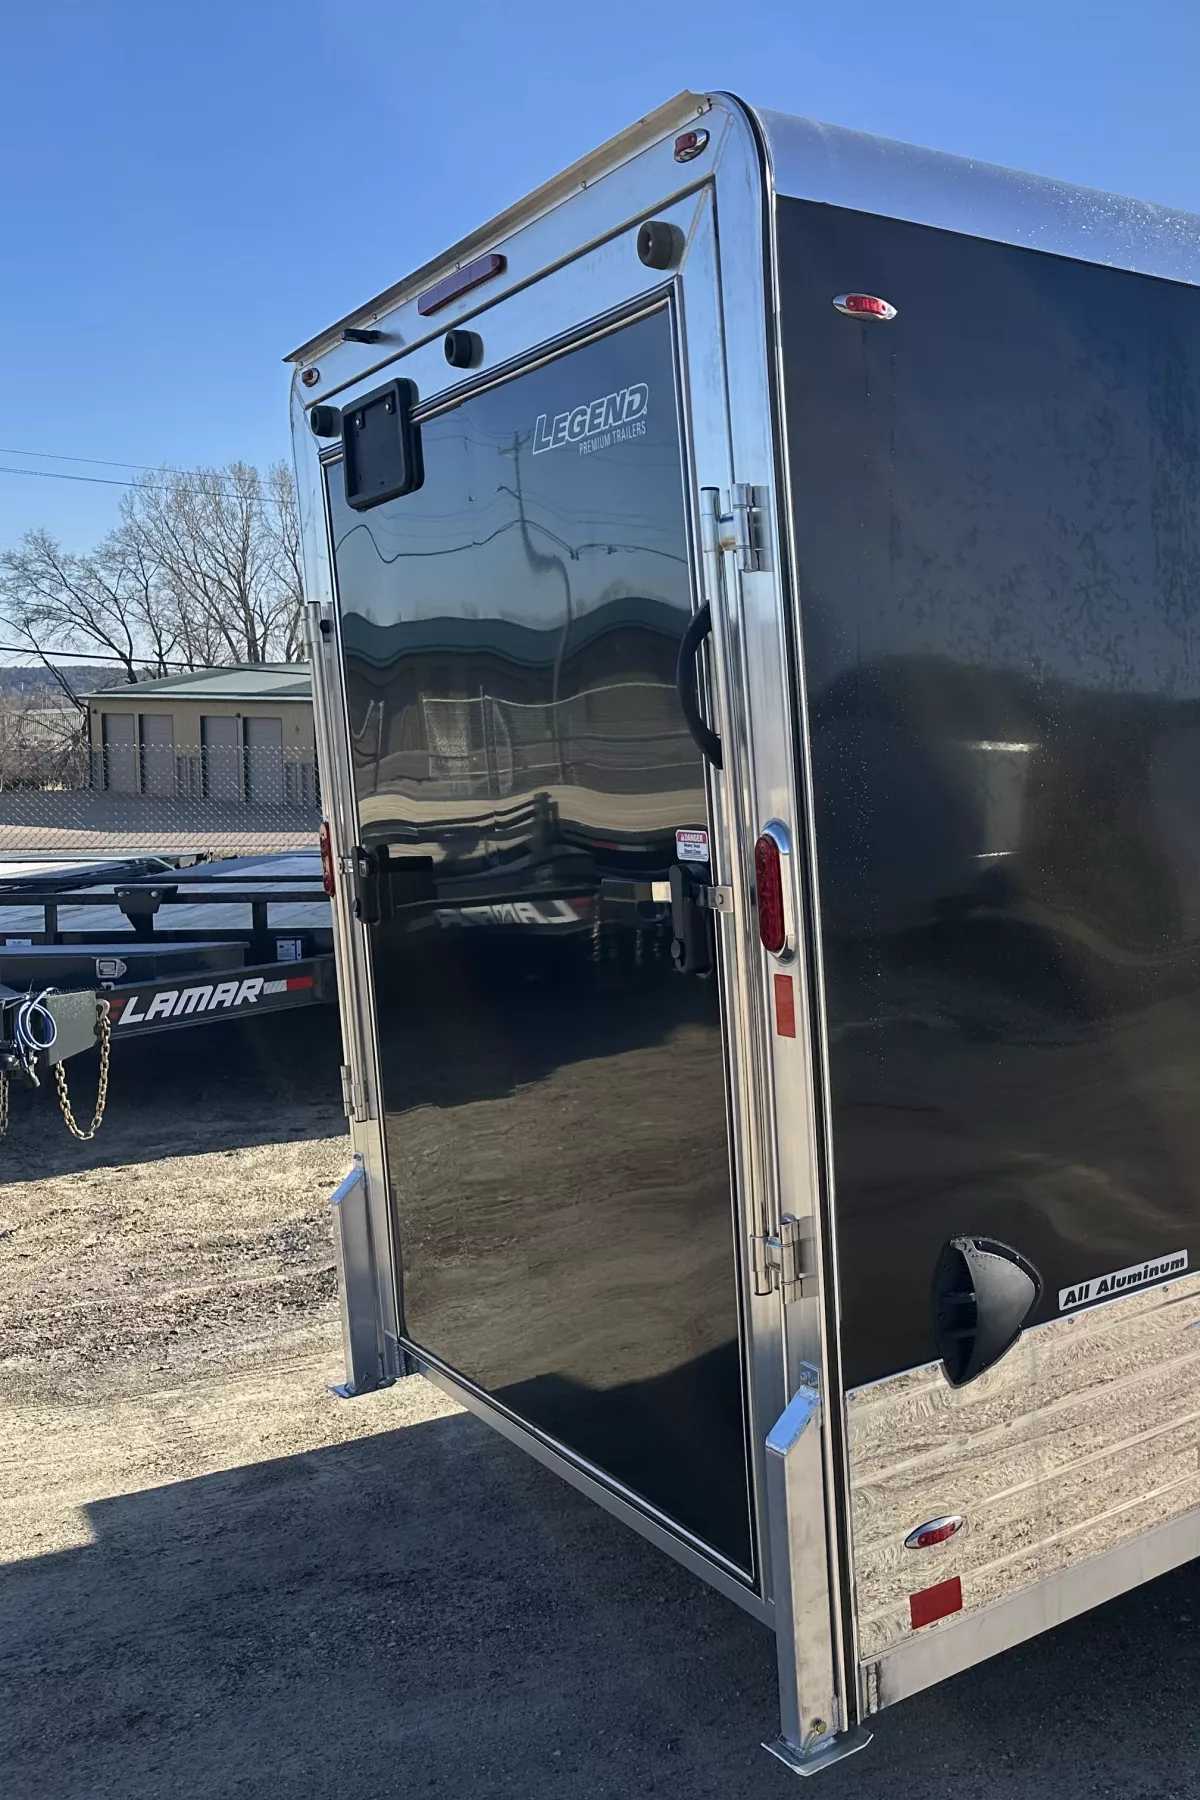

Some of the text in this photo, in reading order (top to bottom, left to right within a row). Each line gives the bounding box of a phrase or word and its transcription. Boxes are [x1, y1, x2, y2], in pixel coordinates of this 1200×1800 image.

[533, 383, 649, 455] LEGEND
[579, 421, 647, 456] PREMIUM TRAILERS
[684, 834, 703, 842] DANGER
[118, 977, 264, 1025] LAMAR
[1063, 1256, 1185, 1306] All Aluminum
